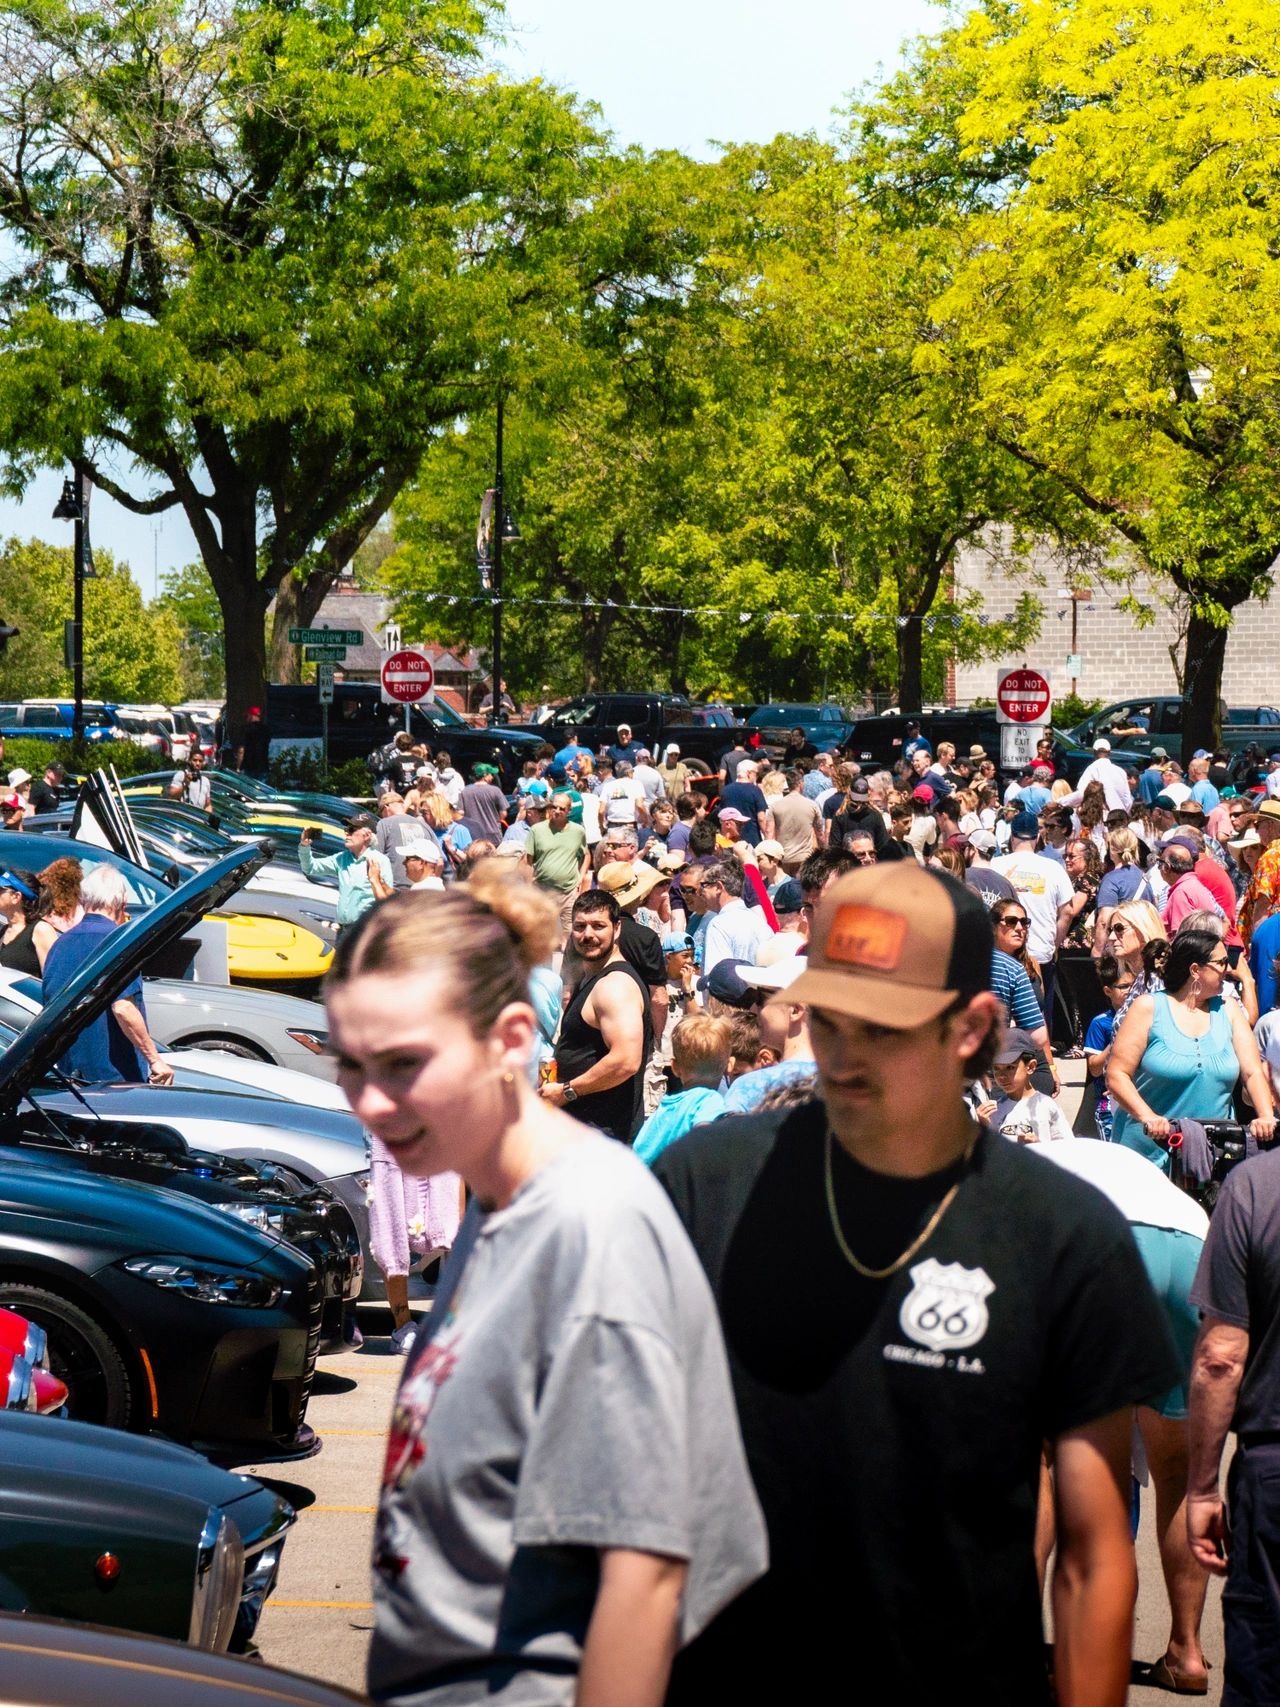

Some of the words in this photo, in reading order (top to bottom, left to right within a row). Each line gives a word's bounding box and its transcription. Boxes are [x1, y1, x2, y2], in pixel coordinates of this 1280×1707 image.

[301, 631, 343, 643] Glenview
[346, 632, 358, 643] Rd
[390, 661, 402, 670] DO
[407, 661, 426, 670] NOT
[320, 666, 333, 675] ONE
[321, 678, 333, 687] WAY
[1005, 680, 1018, 689] DO
[1024, 680, 1042, 689] NOT
[394, 684, 422, 693] ENTER
[1009, 703, 1039, 713] ENTER
[1017, 728, 1027, 736] NO
[1015, 738, 1030, 746] EXIT
[918, 1300, 968, 1335] 66
[882, 1344, 946, 1369] CHICAGO
